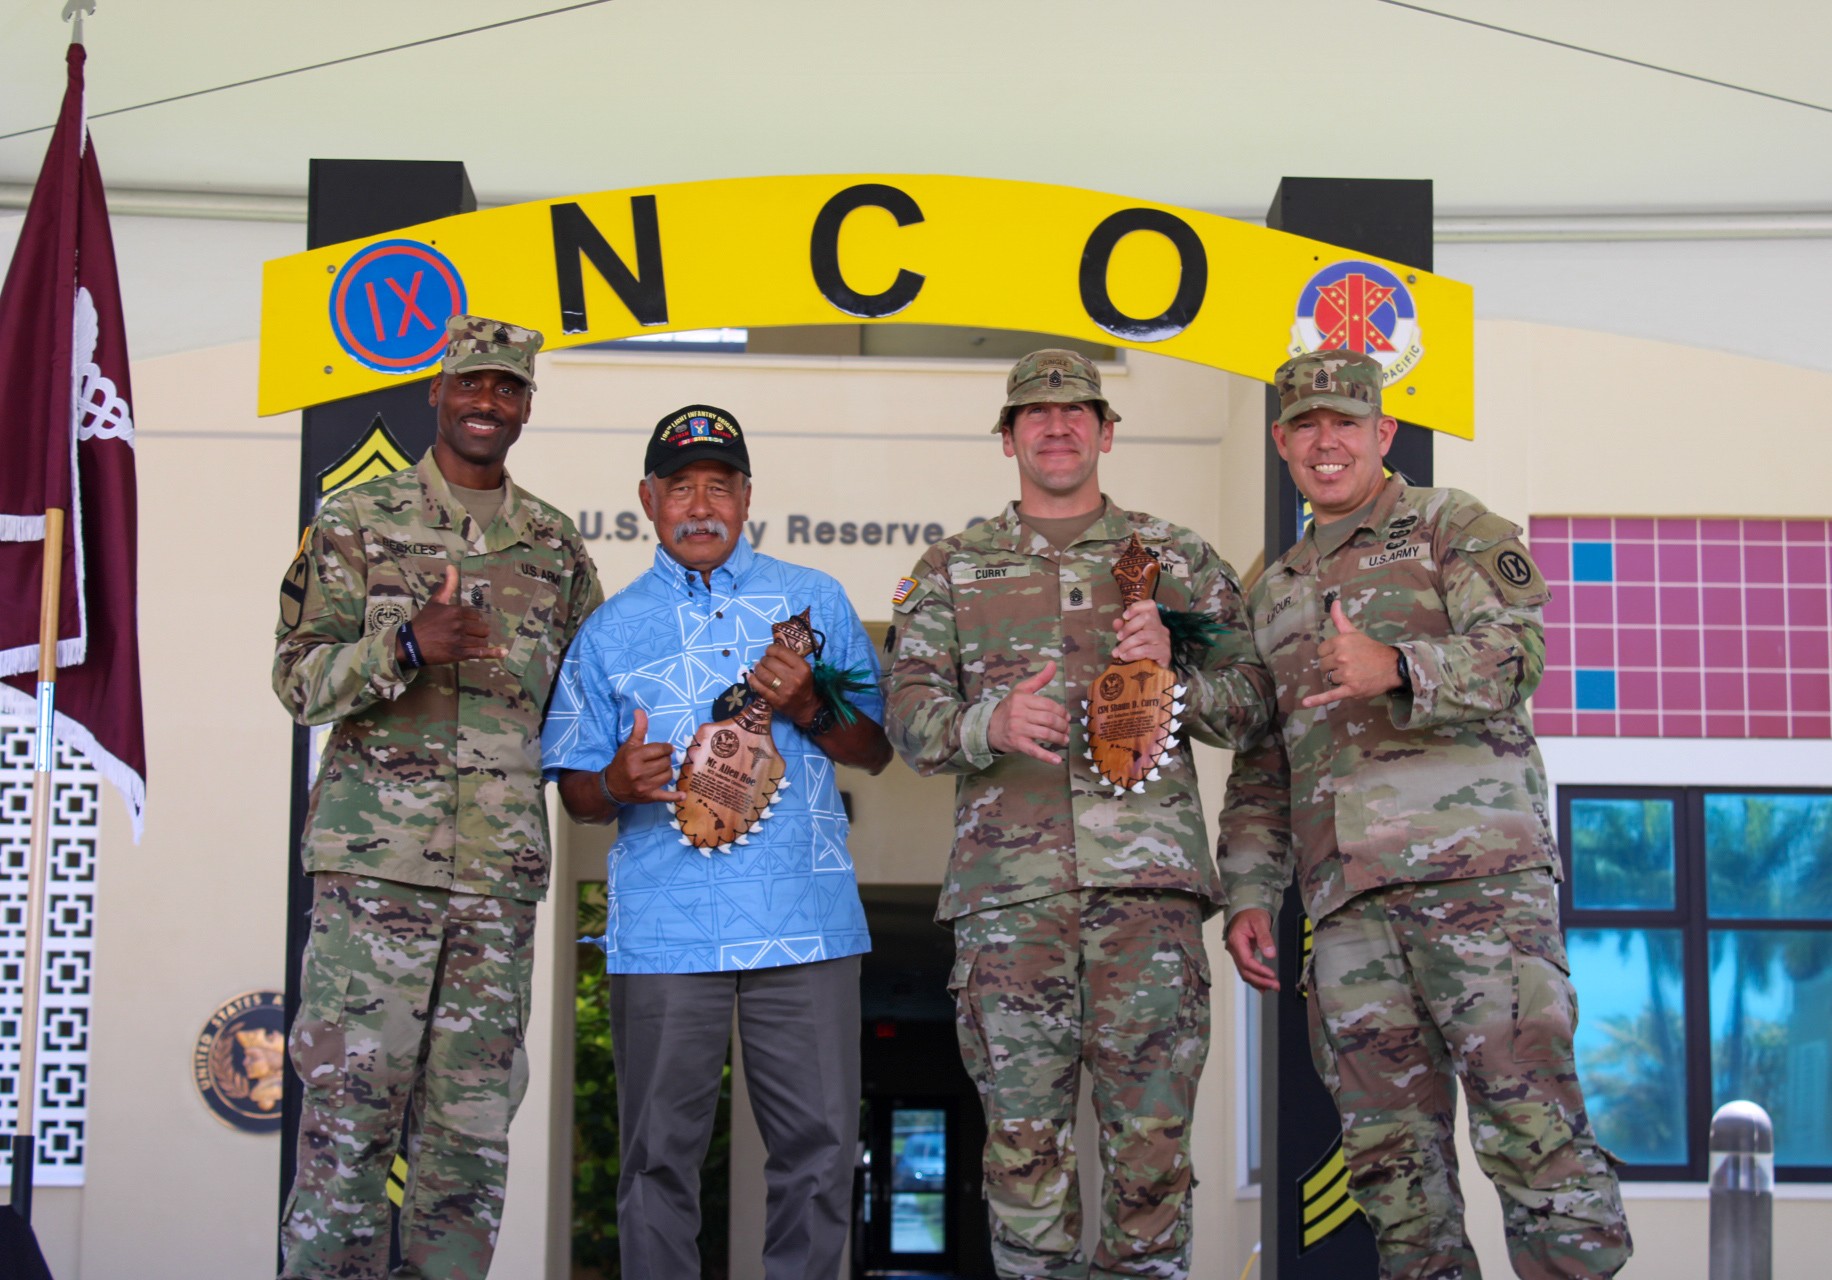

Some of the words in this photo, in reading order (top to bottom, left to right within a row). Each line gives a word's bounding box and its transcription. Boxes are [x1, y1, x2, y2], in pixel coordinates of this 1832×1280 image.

[365, 270, 436, 342] IX
[1383, 344, 1420, 382] PACIFIC
[671, 414, 687, 427] LIGHT
[687, 410, 717, 419] INFANTRY
[717, 416, 739, 437] BRIGADE
[579, 511, 649, 541] U.S.
[787, 515, 944, 545] Reserve
[383, 537, 437, 556] BECKLES
[976, 568, 1007, 580] CURRY
[1502, 558, 1526, 578] IX
[1141, 699, 1159, 707] Curry
[706, 757, 718, 769] Mr.
[719, 763, 740, 779] Allen
[740, 773, 756, 787] Hoe
[211, 994, 262, 1028] STATES
